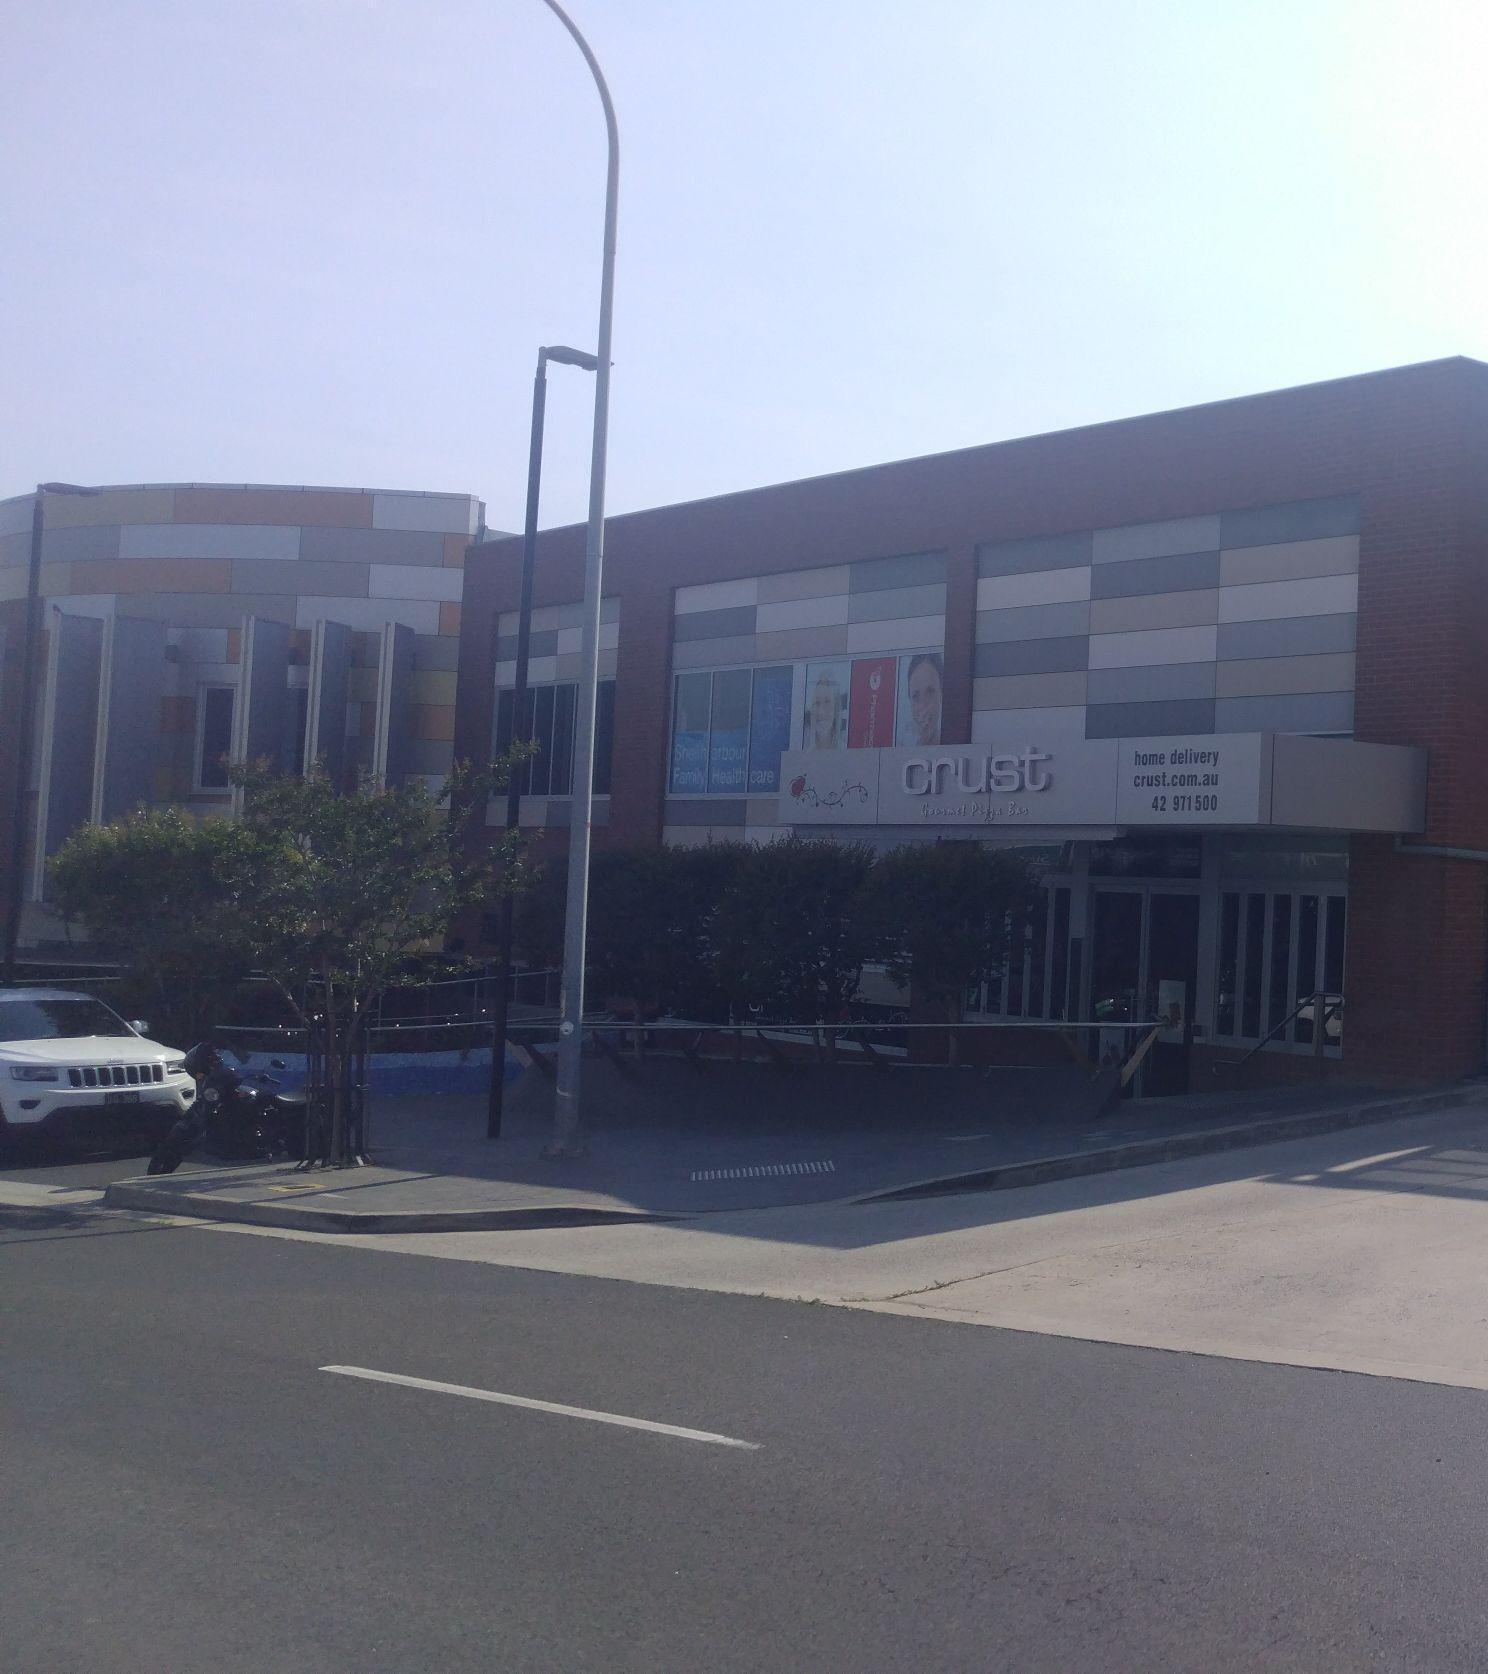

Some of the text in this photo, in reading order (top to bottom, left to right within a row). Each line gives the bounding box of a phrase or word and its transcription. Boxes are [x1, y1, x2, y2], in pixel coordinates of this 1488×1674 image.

[1133, 748, 1220, 768] home delivery
[903, 746, 1052, 796] crust
[1133, 771, 1219, 788] crust.com.au
[1151, 794, 1167, 812] 42
